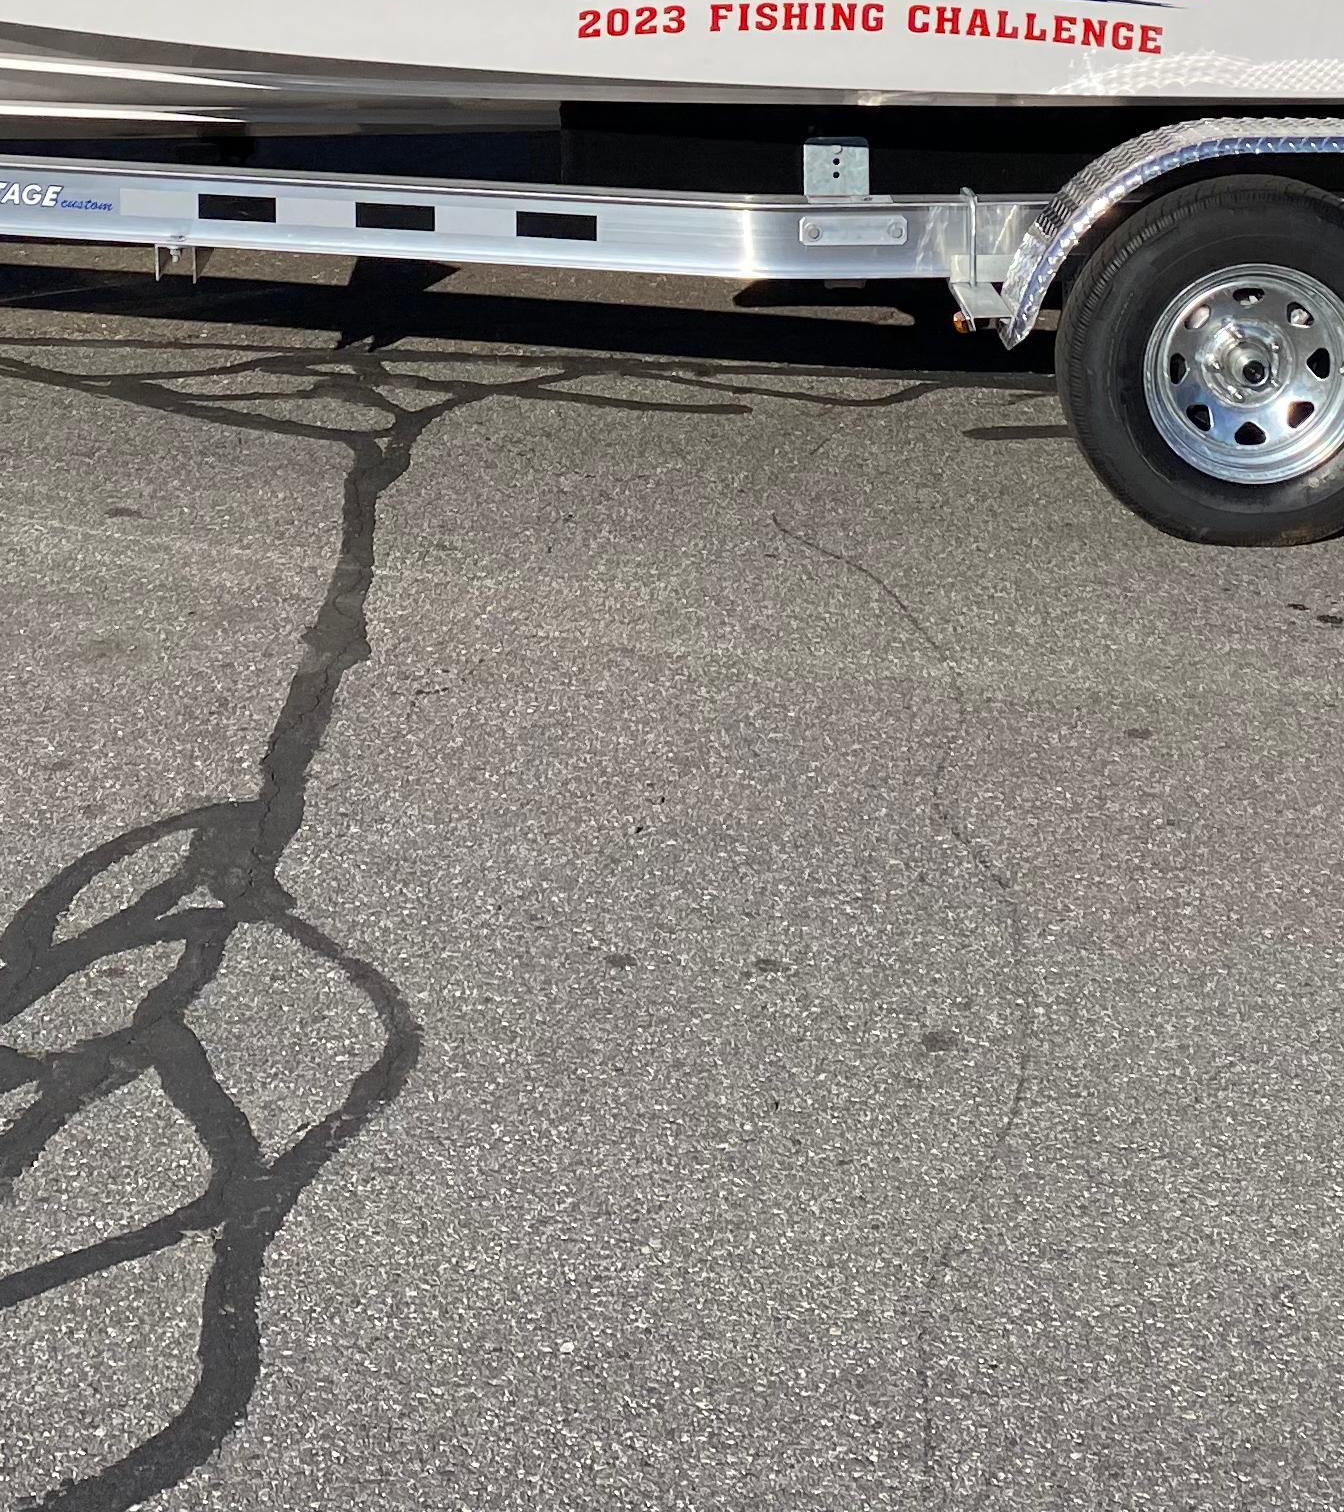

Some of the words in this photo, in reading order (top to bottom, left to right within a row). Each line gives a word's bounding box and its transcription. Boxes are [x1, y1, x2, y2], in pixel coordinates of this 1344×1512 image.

[577, 7, 687, 39] 2023
[709, 2, 885, 33] FISHING
[907, 3, 1164, 55] CHALLENGE
[60, 199, 113, 211] custom
